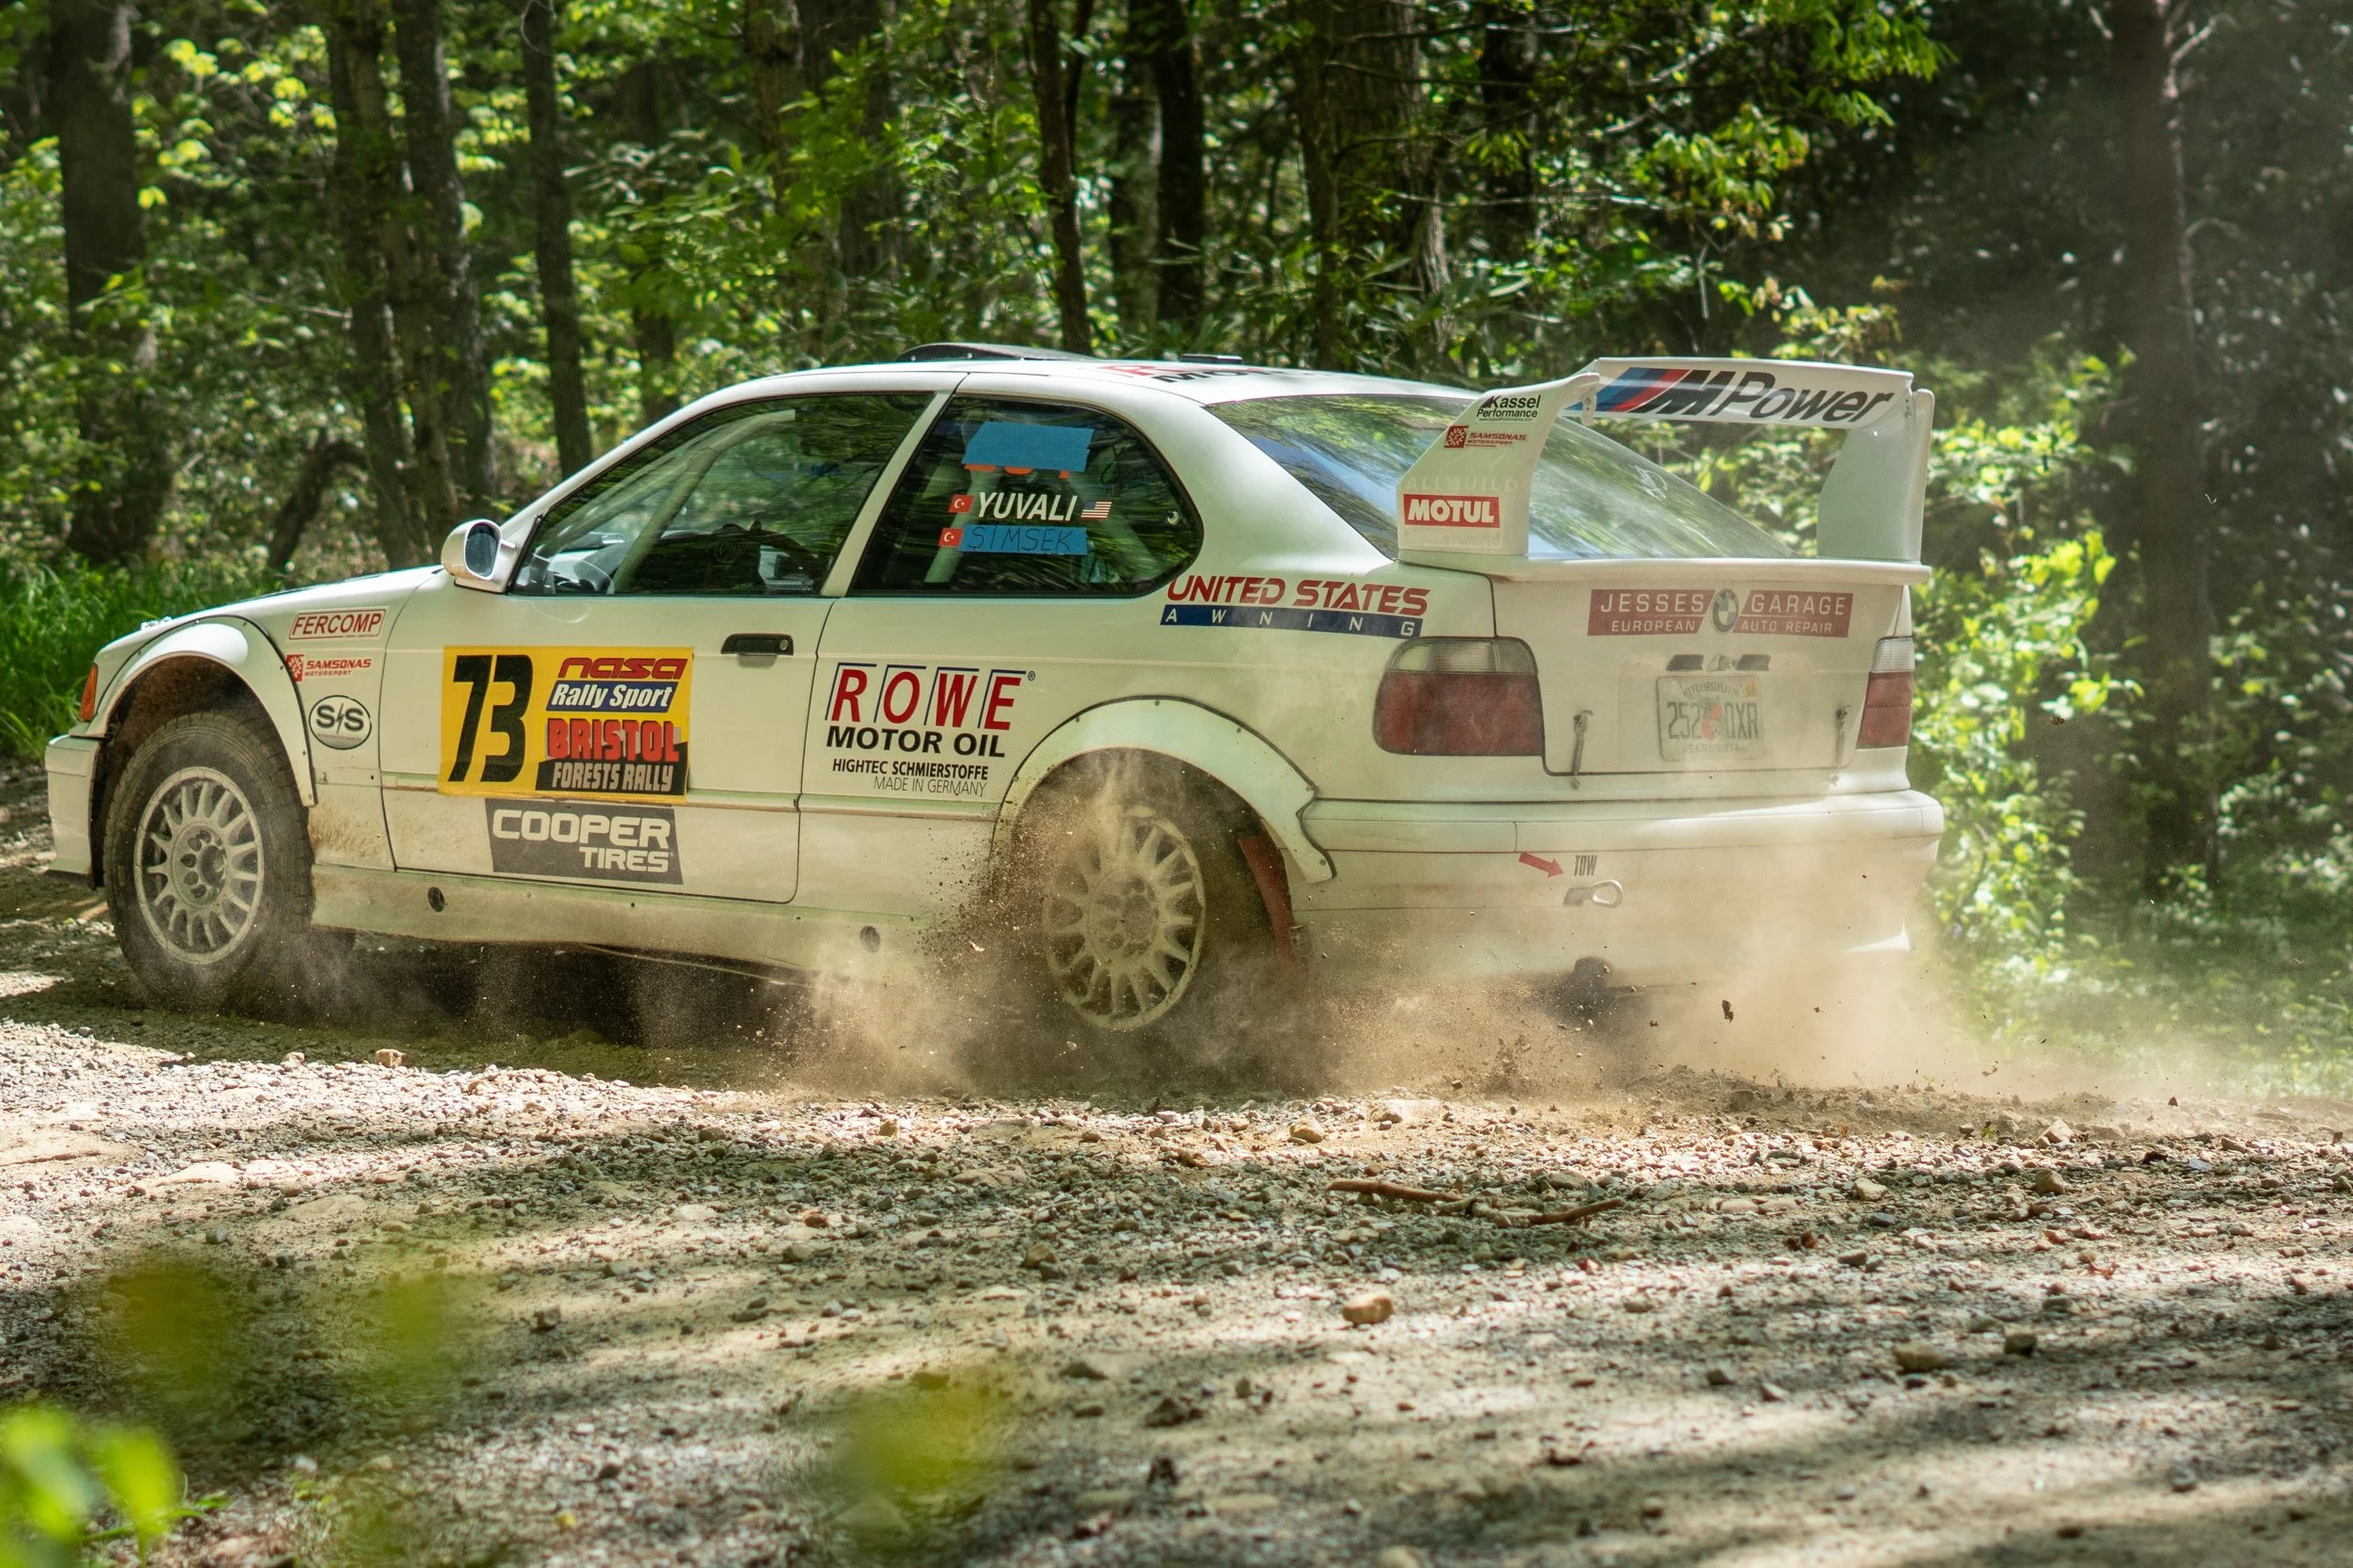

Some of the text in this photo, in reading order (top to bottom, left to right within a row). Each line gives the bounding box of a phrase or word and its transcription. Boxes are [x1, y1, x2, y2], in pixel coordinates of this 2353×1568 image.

[1476, 408, 1538, 418] Performance
[1481, 394, 1542, 408] Kassel
[978, 492, 1078, 521] YUVALI
[1408, 499, 1495, 523] MOTUL
[1167, 575, 1431, 616] UNITED STATES
[1600, 593, 1846, 616] JESSES GARAGE
[292, 613, 382, 635] FERCOMP
[1611, 619, 1833, 634] EUROPEAN AUTO REPAIR
[306, 659, 372, 669] SAMSONAS
[551, 682, 673, 710] Rally Sport
[447, 654, 534, 782] 73
[547, 718, 680, 762] BRISTOL
[826, 726, 1005, 759] MOTOR OIL
[552, 762, 674, 792] FORESTS RALLY
[832, 759, 989, 781] HIGHTEC SCHMIERSTOFFE
[873, 776, 987, 796] MADE IN GERMANY
[492, 808, 671, 849] COOPER
[579, 847, 669, 873] TIRES
[1574, 855, 1598, 876] TOW
